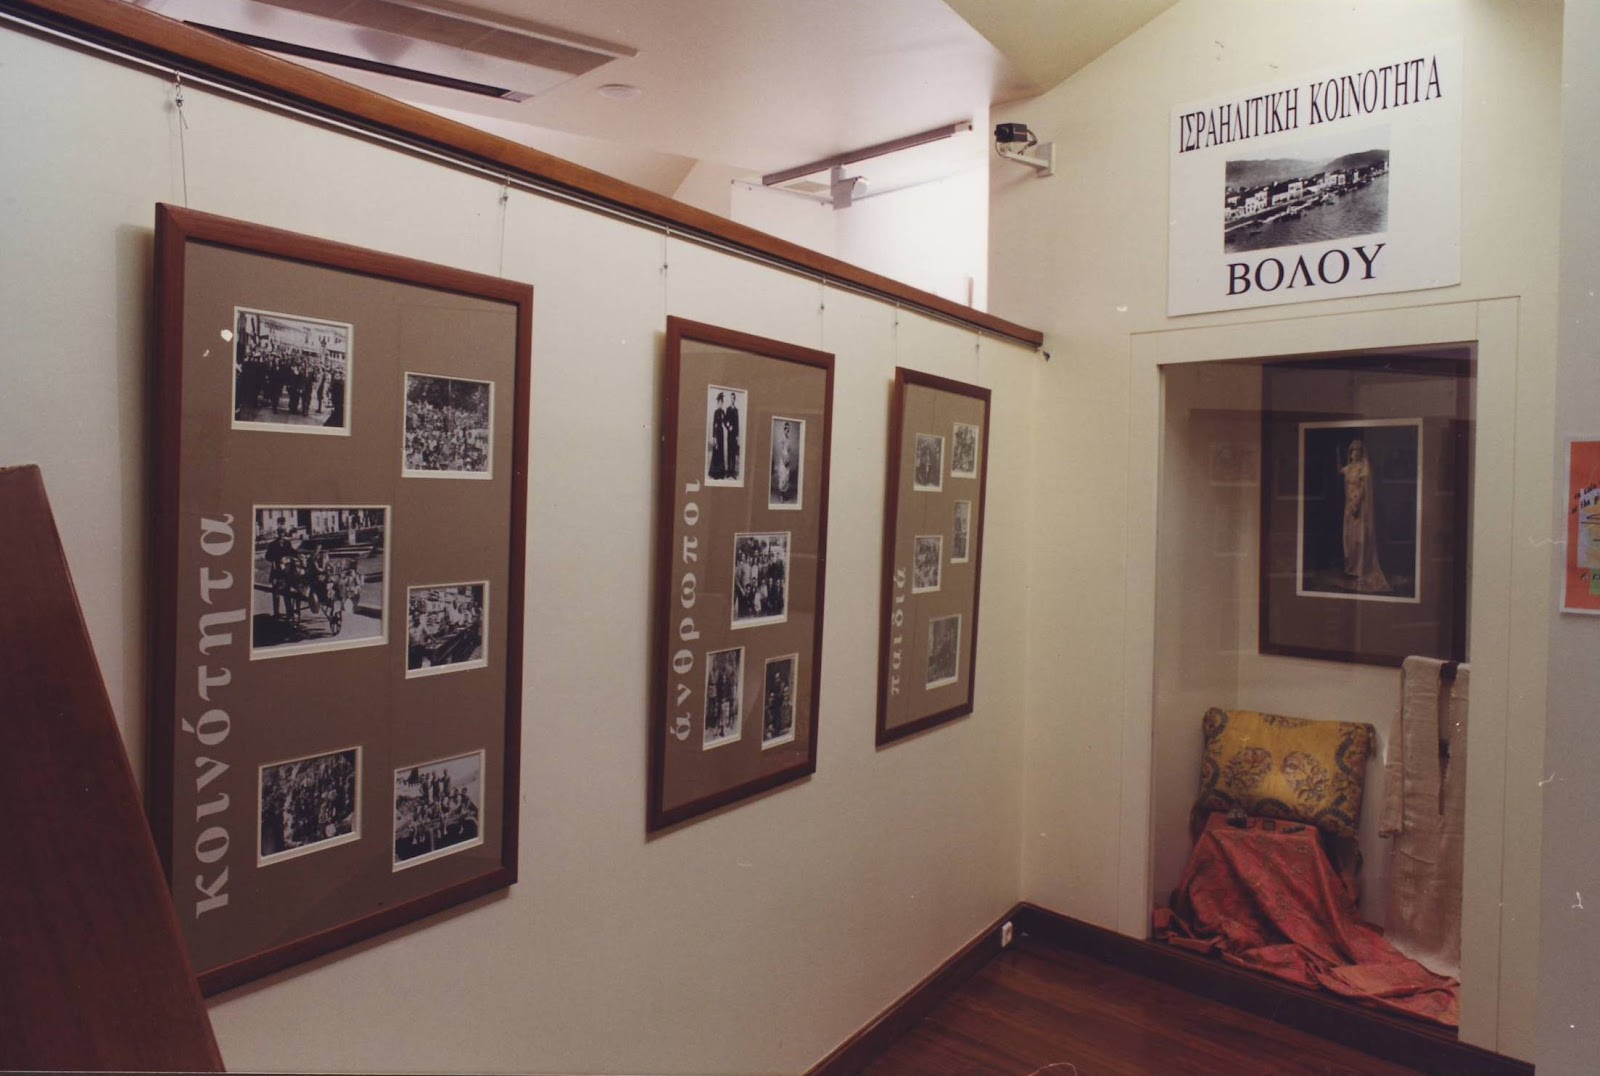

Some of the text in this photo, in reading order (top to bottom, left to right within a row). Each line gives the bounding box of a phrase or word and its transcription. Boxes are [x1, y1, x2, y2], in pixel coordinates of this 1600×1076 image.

[1179, 55, 1442, 153] ΙΣΡΑΗΛΙΤΙΚΗ ΚΟΙΝΟΤΗΤΑ
[1225, 243, 1386, 296] ΒΟΛΟΥ
[670, 479, 701, 741] άνθρωποι
[890, 567, 906, 696] παιδιά
[181, 513, 247, 919] κοινότητα
